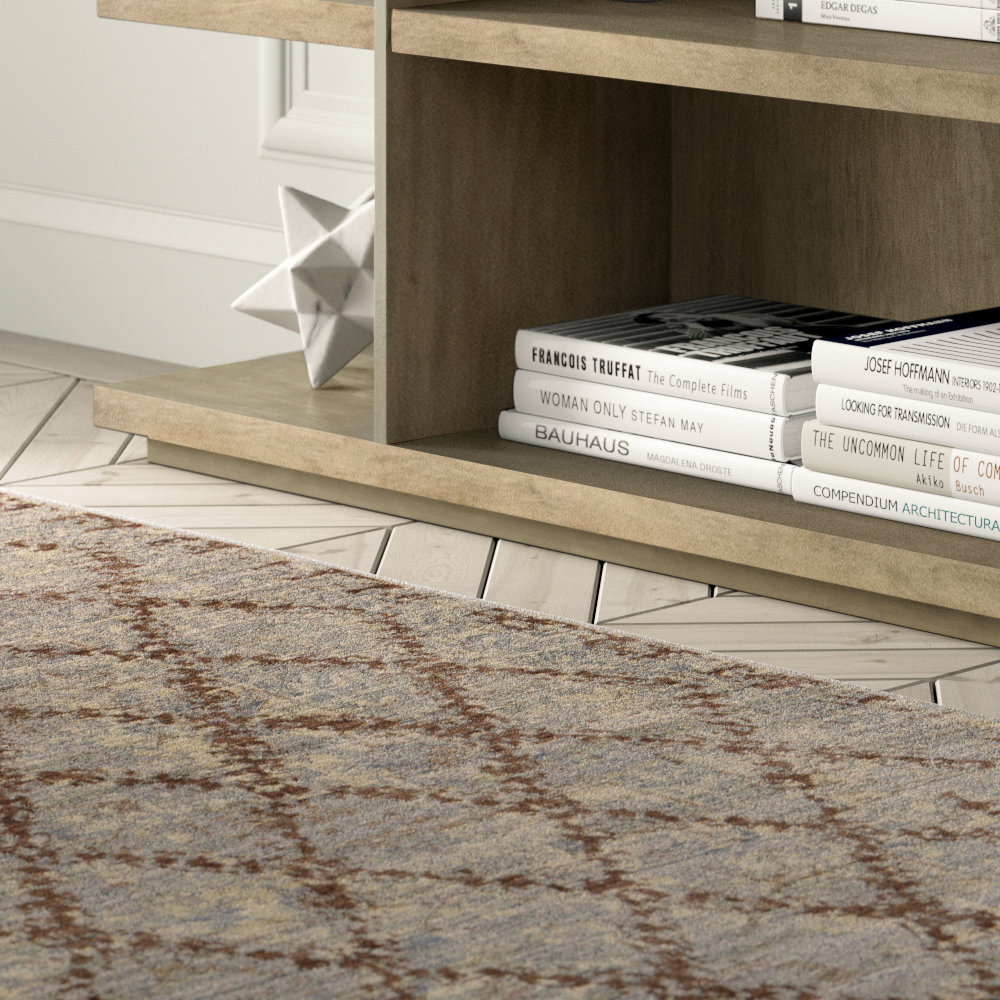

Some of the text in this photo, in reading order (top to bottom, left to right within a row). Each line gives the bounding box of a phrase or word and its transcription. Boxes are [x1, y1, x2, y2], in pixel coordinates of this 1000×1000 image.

[787, 2, 798, 10] 1
[820, 1, 878, 14] EDGAR DEGAS
[531, 346, 749, 400] FRANCOIS TRUFFAT The Complete Films
[864, 356, 893, 375] JOSEF
[894, 361, 951, 385] HOFFMANN
[952, 376, 982, 391] INTERIORS
[902, 384, 914, 394] The
[914, 388, 934, 399] making
[948, 391, 974, 404] Exhibition
[539, 389, 705, 434] WOMAN ONLY STEFAN MAY
[841, 397, 876, 417] LOOKING
[877, 404, 893, 418] FOR
[894, 406, 951, 429] TRANSMISSION
[956, 422, 967, 432] DIE
[968, 425, 989, 437] FORM
[535, 424, 733, 477] BAUHAUS MAGDALENA DROSTE
[812, 429, 835, 450] THE
[842, 435, 905, 463] UNCOMMON
[914, 448, 945, 471] LIFE
[952, 456, 969, 474] OF
[776, 462, 786, 494] ASCHEN
[916, 472, 985, 497] Akiko Busch
[813, 485, 898, 513] COMPENDIUM
